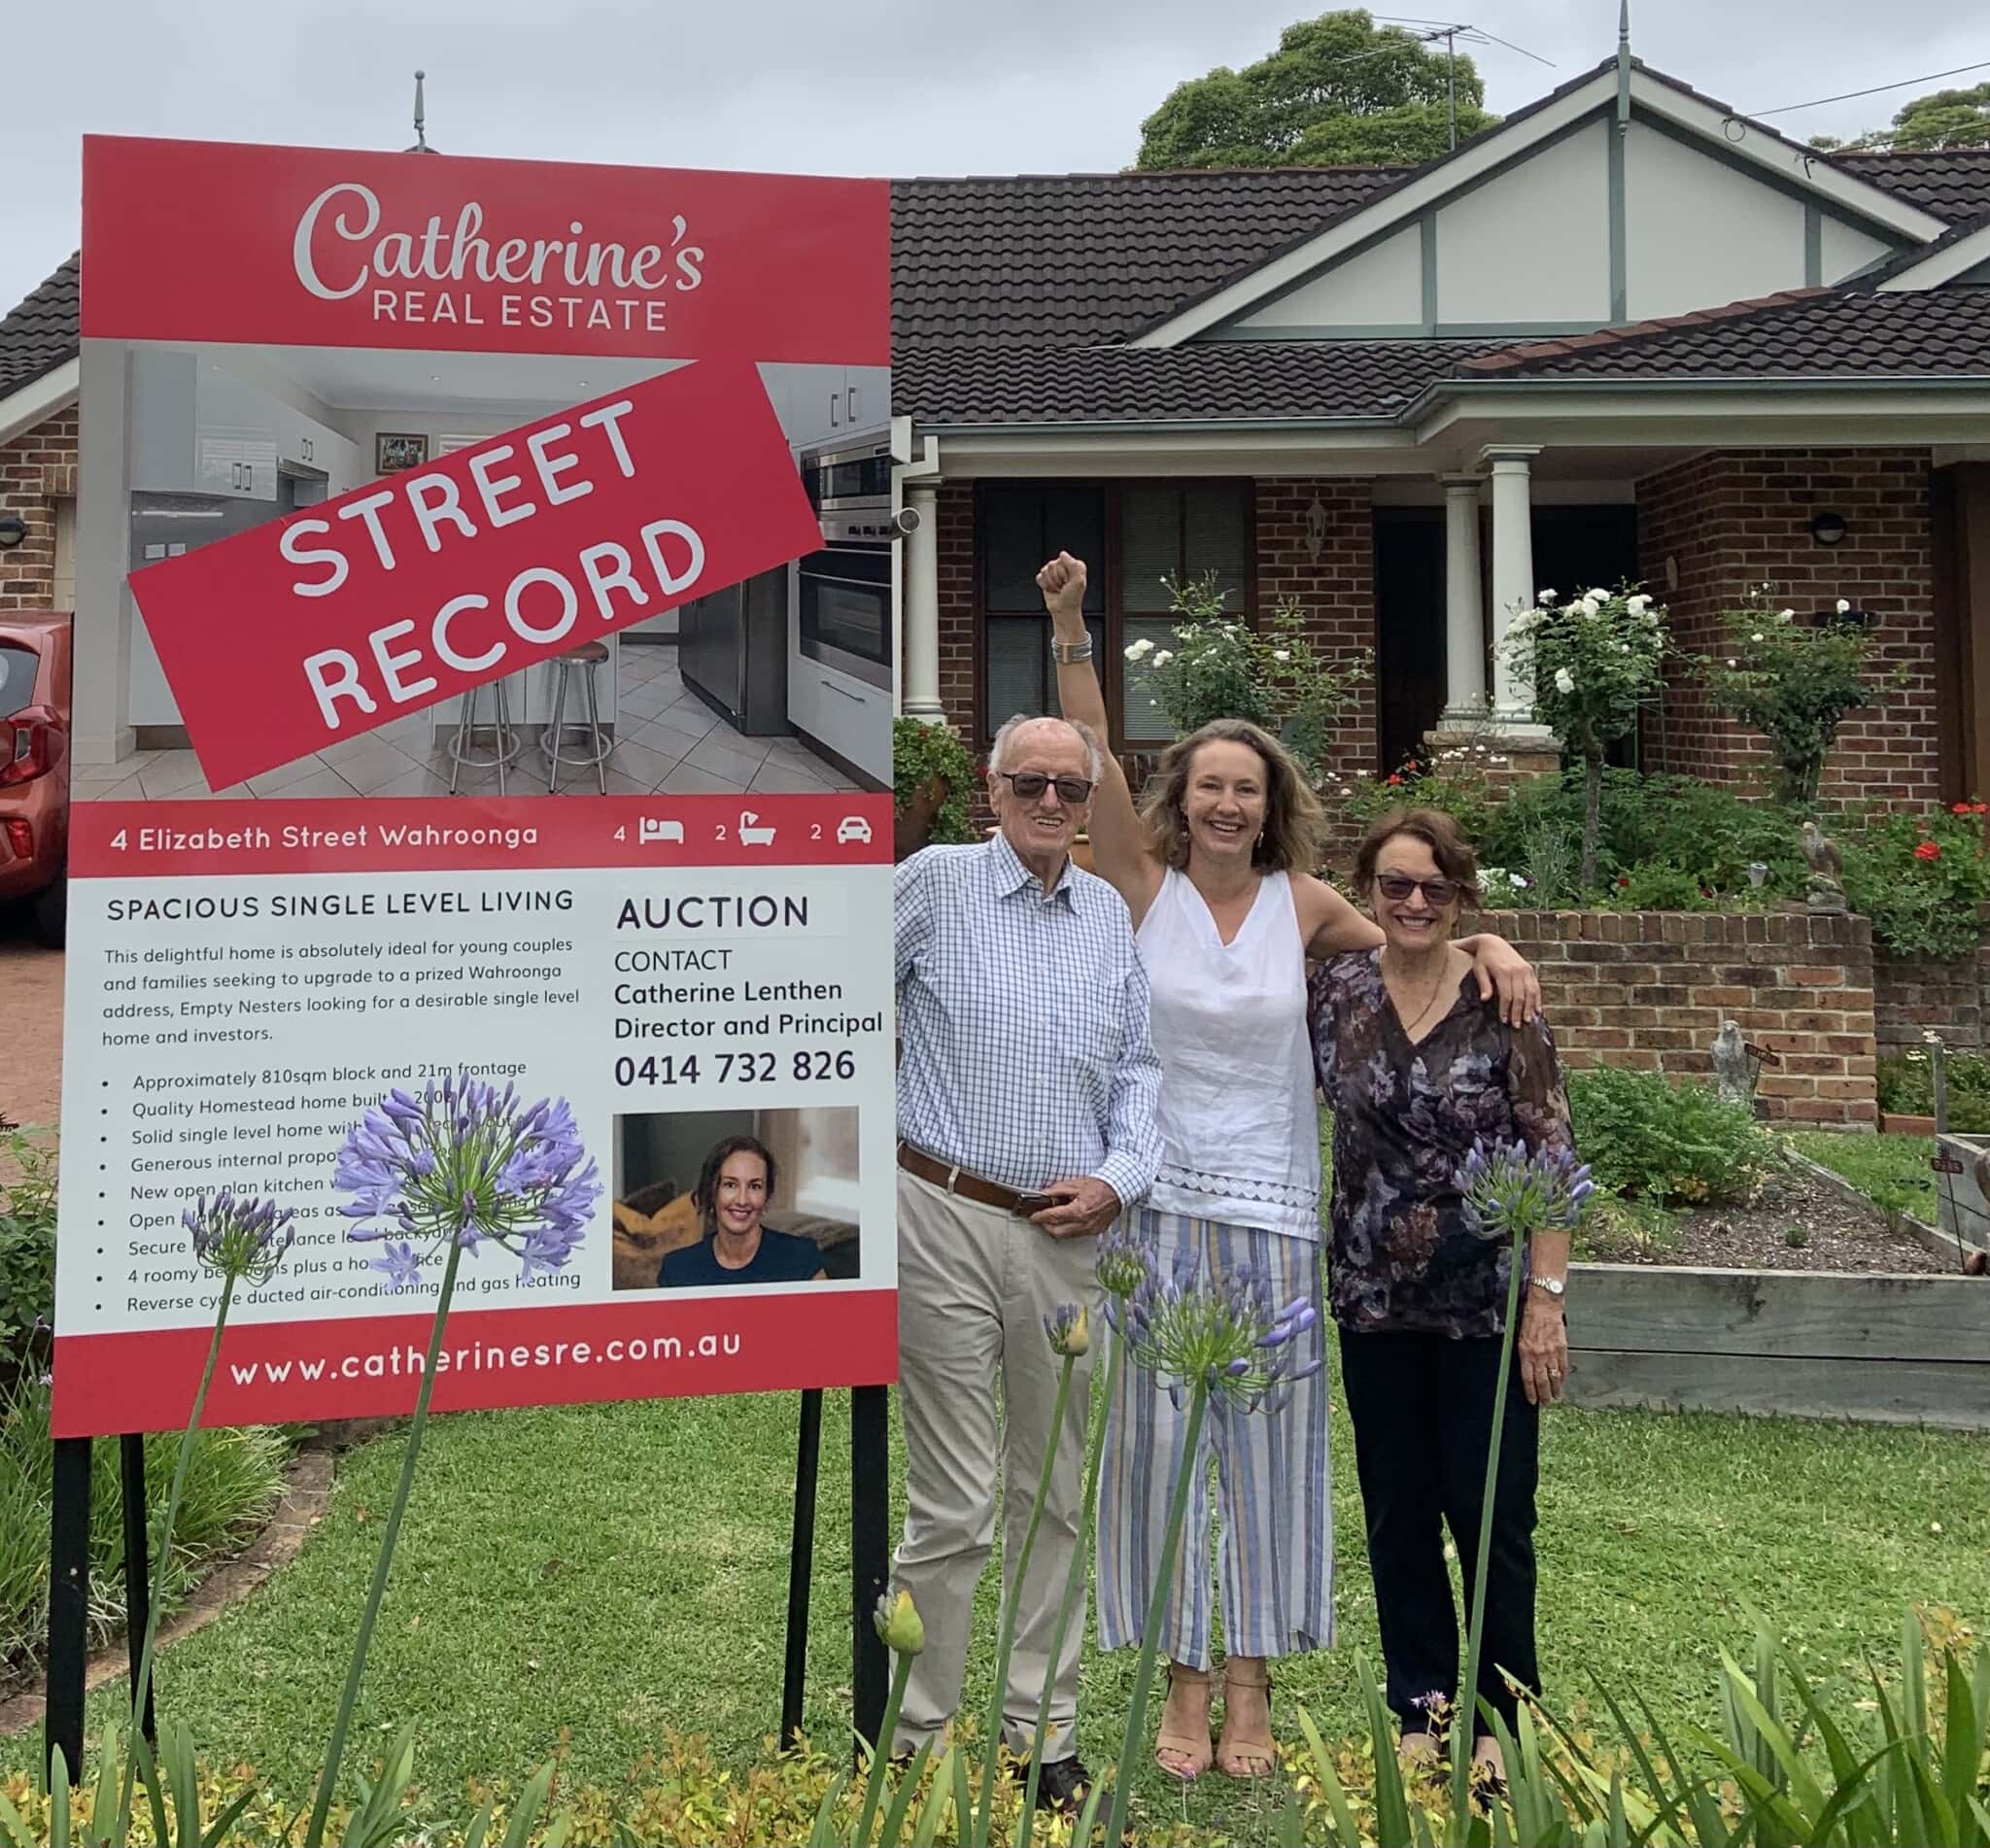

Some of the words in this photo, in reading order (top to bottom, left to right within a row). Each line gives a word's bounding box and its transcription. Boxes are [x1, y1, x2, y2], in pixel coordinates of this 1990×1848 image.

[374, 290, 484, 324] REAL
[502, 295, 666, 331] ESTATE
[280, 399, 637, 598] STREET
[303, 519, 705, 730] RECORD
[111, 830, 127, 850] 4
[140, 828, 269, 850] Elizabeth
[283, 826, 366, 847] Street
[379, 825, 536, 848] Wahroonga
[614, 826, 625, 841] 4
[715, 825, 726, 840] 2
[811, 824, 821, 839] 2
[108, 897, 258, 920] SPACIOUS
[271, 895, 374, 916] SINGLE
[388, 893, 470, 913] LEVEL
[482, 890, 572, 911] LIVING
[617, 896, 807, 929] AUCTION
[104, 950, 138, 964] This
[144, 947, 223, 965] delightful
[229, 946, 275, 960] home
[282, 945, 292, 958] is
[299, 942, 383, 959] absolutely
[389, 941, 426, 955] ideal
[432, 941, 455, 954] for
[460, 942, 507, 956] young
[513, 938, 572, 954] couples
[615, 949, 733, 972] CONTACT
[104, 976, 136, 991] and
[143, 975, 207, 989] families
[213, 973, 275, 989] seeking
[282, 973, 298, 985] to
[304, 970, 372, 987] upgrade
[379, 970, 395, 982] to
[400, 972, 409, 981] a
[416, 967, 463, 984] prized
[469, 966, 561, 980] Wahroonga
[103, 1003, 174, 1018] address,
[181, 1002, 232, 1018] Empty
[239, 1000, 301, 1013] Nesters
[308, 997, 365, 1012] looking
[373, 995, 395, 1009] for
[400, 998, 409, 1008] a
[416, 992, 488, 1008] desirable
[494, 991, 538, 1008] single
[545, 989, 578, 1003] level
[615, 982, 735, 1004] Catherine
[745, 980, 841, 1001] Lenthen
[103, 1032, 150, 1045] home
[156, 1029, 188, 1044] and
[194, 1029, 272, 1042] investors.
[616, 1018, 715, 1039] Director
[724, 1014, 769, 1035] and
[780, 1011, 881, 1037] Principal
[133, 1071, 257, 1092] Approximately
[262, 1070, 326, 1085] 810sqm
[333, 1066, 375, 1080] block
[381, 1065, 411, 1078] and
[418, 1064, 452, 1078] 21m
[459, 1062, 527, 1077] frontage
[615, 1055, 701, 1086] 0414
[715, 1052, 775, 1082] 732
[793, 1050, 854, 1080] 826
[133, 1102, 193, 1119] Quality
[200, 1096, 294, 1113] Homestead
[301, 1096, 346, 1109] home
[353, 1093, 389, 1107] built
[132, 1129, 173, 1145] Solid
[180, 1127, 227, 1145] single
[234, 1124, 270, 1139] level
[277, 1124, 323, 1137] home
[131, 1158, 212, 1172] Generous
[218, 1151, 282, 1168] internal
[131, 1186, 168, 1199] New
[174, 1185, 215, 1203] open
[223, 1179, 257, 1196] plan
[264, 1178, 324, 1192] kitchen
[129, 1214, 175, 1230] Open
[273, 1207, 319, 1220] aeas
[325, 1205, 341, 1217] as
[129, 1242, 186, 1255] Secure
[128, 1270, 137, 1283] 4
[145, 1270, 198, 1283] roomy
[293, 1259, 326, 1278] plus
[332, 1261, 342, 1272] a
[127, 1298, 193, 1312] Reverse
[248, 1287, 304, 1304] ducted
[451, 1278, 476, 1292] nd
[482, 1279, 509, 1293] gas
[516, 1274, 580, 1288] heating
[230, 1332, 740, 1386] www.catherinesre.com.au
